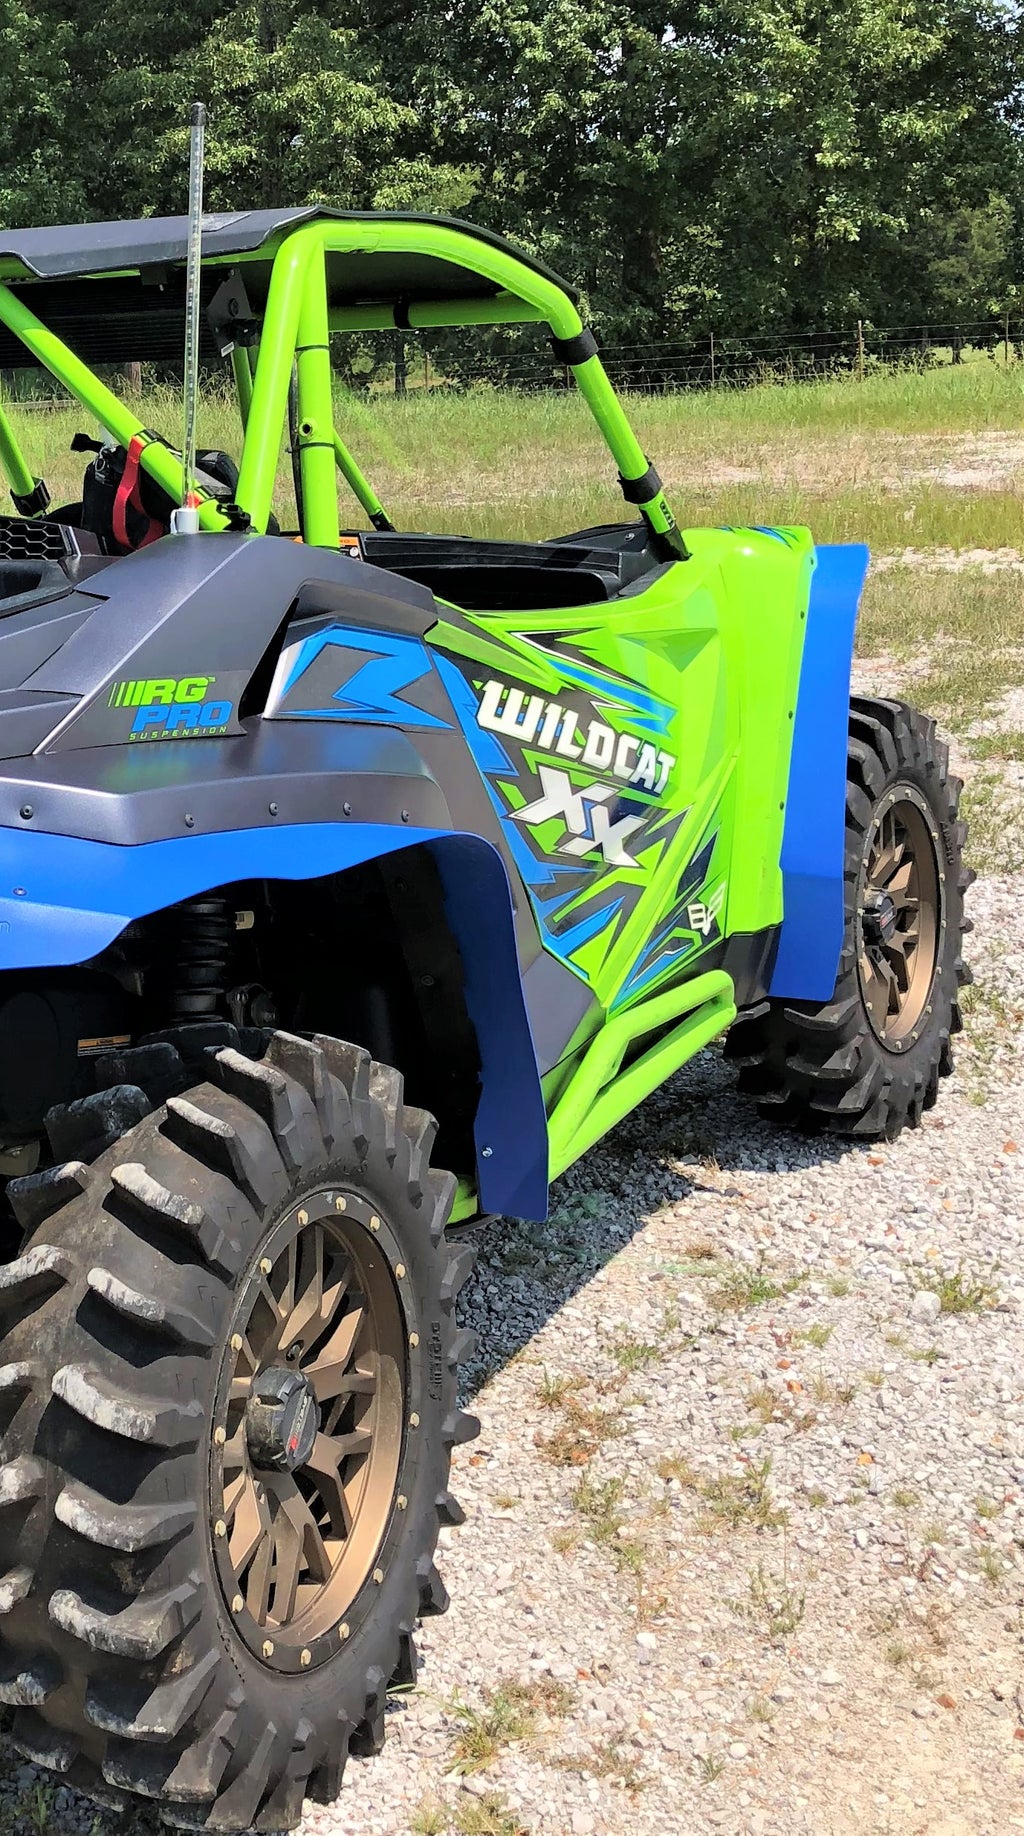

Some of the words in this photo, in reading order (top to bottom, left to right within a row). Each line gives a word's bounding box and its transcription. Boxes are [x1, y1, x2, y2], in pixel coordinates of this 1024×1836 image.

[129, 726, 227, 741] SUSPENSION
[132, 701, 233, 732] PRO
[476, 679, 676, 794] WILDCAT
[507, 764, 649, 868] XX
